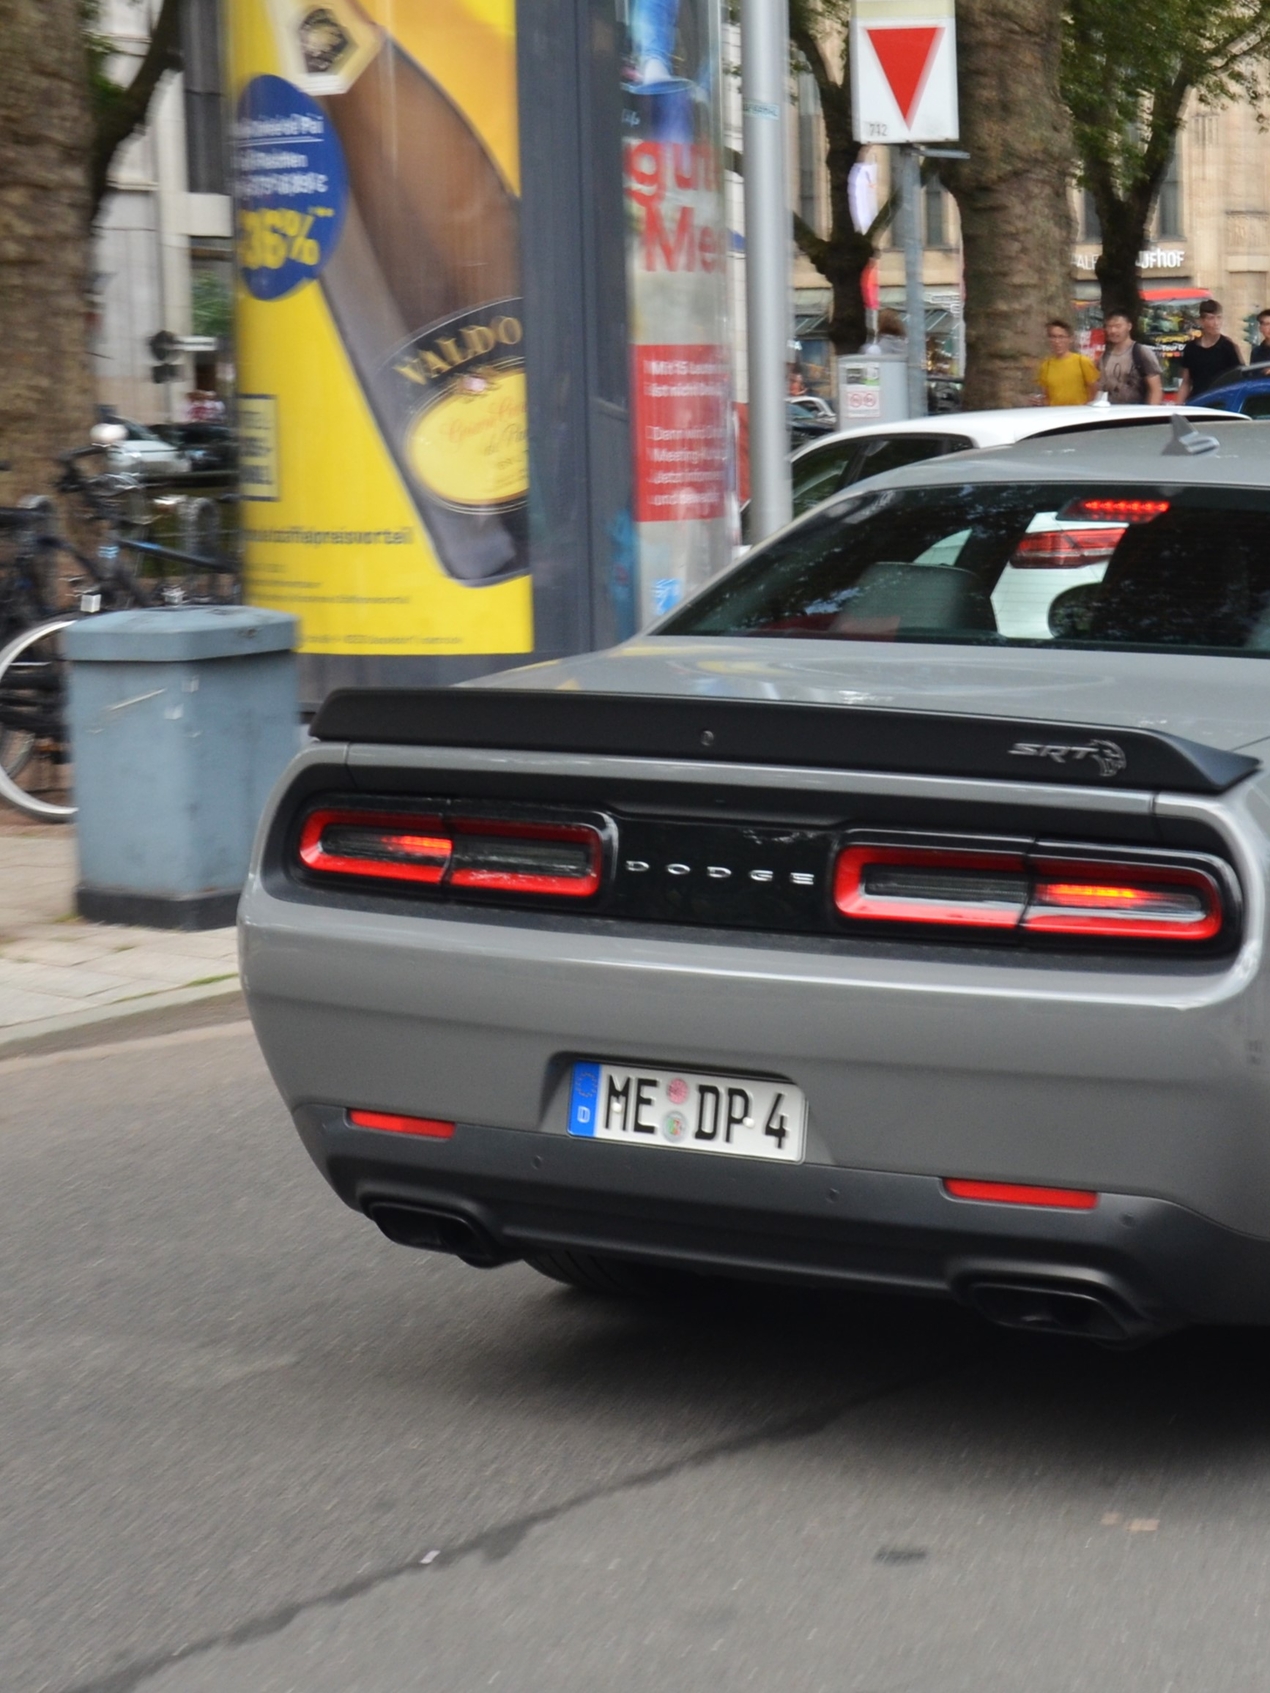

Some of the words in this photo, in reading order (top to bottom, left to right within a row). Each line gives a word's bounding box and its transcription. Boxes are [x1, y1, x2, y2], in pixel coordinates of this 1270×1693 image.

[394, 316, 523, 385] VALDO
[1007, 742, 1099, 764] SRT
[625, 859, 815, 886] DODGE
[604, 1074, 658, 1134] ME
[694, 1083, 750, 1143] DP
[764, 1092, 786, 1149] 4
